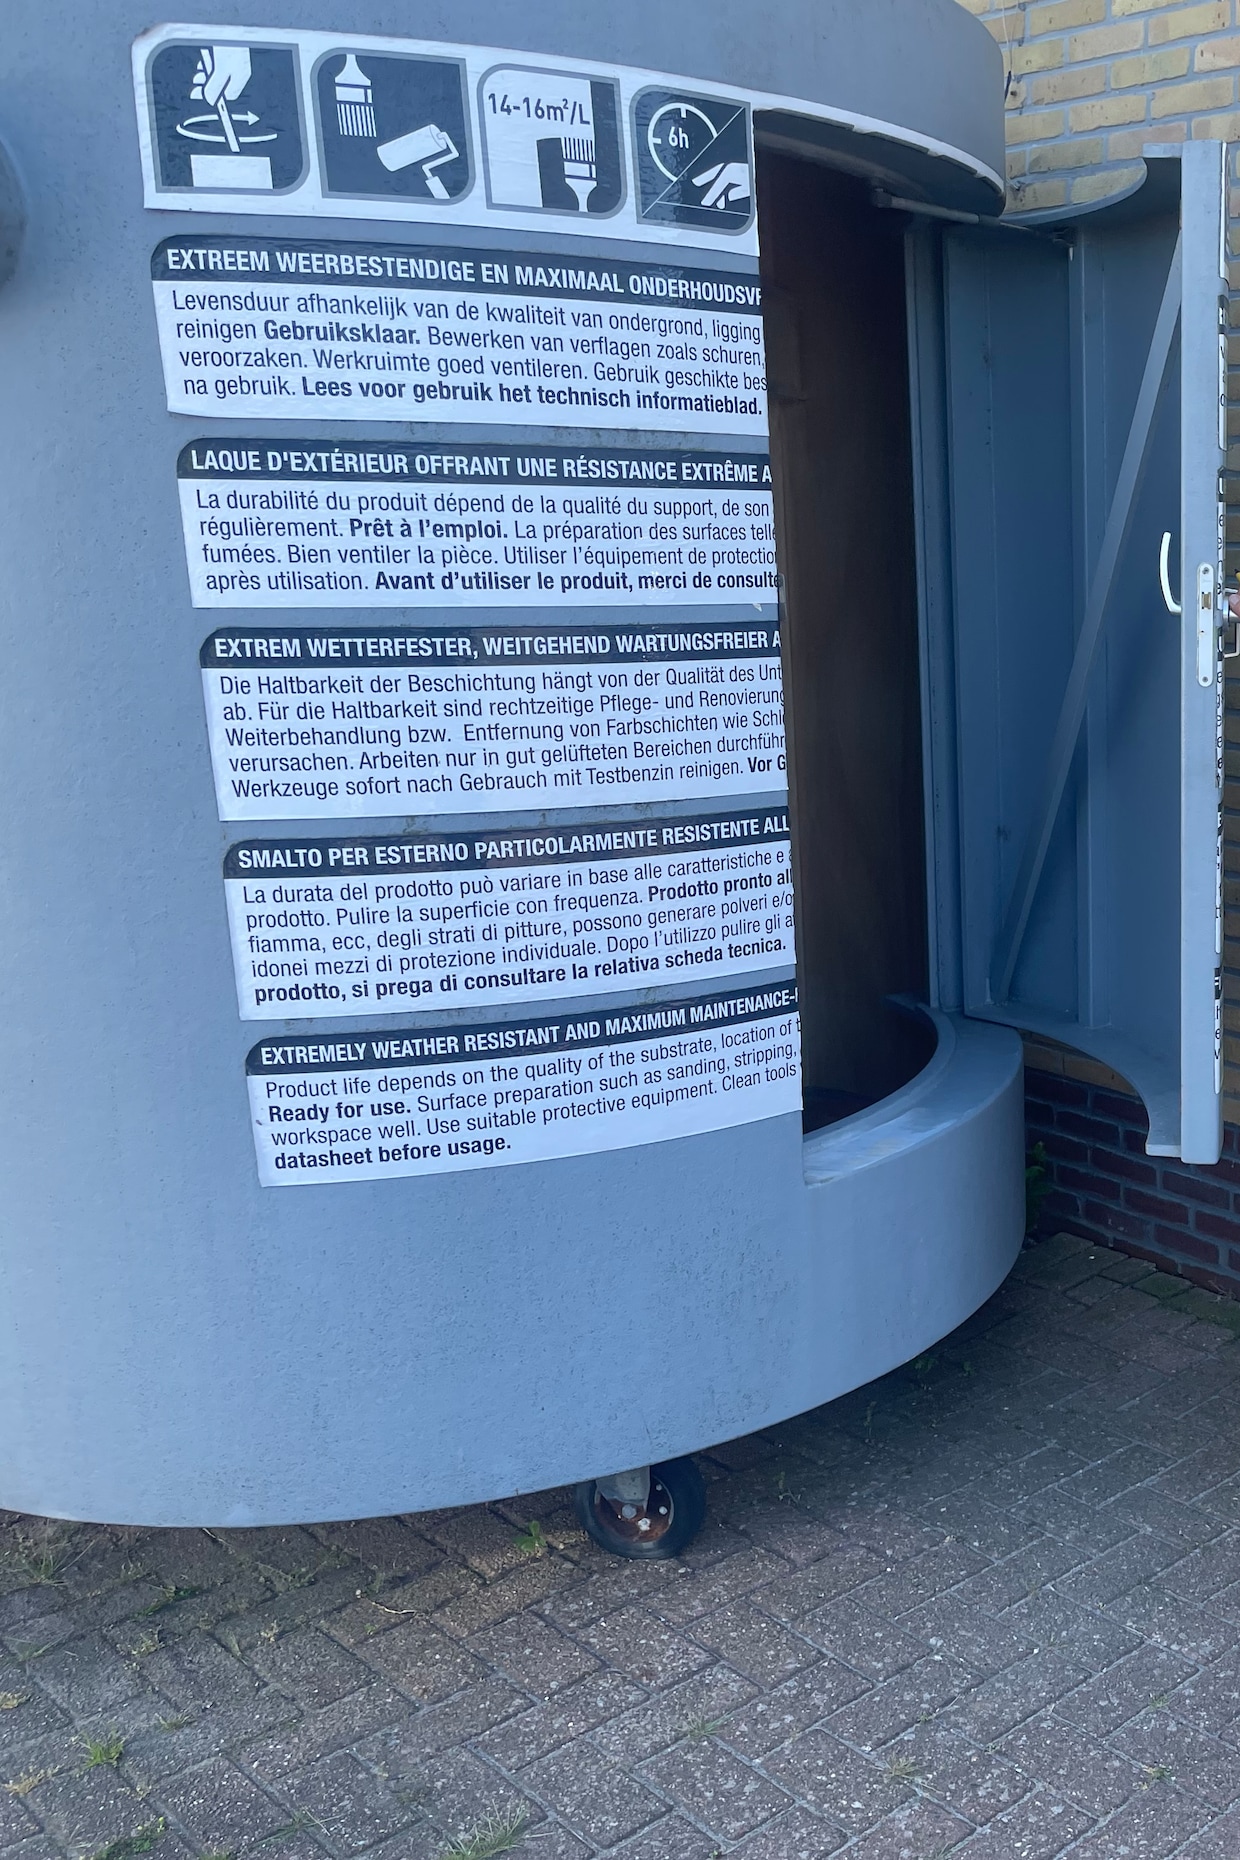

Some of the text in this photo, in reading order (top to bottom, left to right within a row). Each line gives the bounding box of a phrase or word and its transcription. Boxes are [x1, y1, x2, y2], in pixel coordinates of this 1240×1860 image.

[668, 126, 689, 149] 6h
[167, 249, 624, 293] EXTREEM WEERBESTENDIGE EN MAXIMAAL
[172, 290, 760, 345] Levensduur afhankelijk van de kwaliteit van ondergrond, ligging
[176, 318, 697, 361] reinigen Gebruiksklaar. Bewerken van verflagen zoals
[183, 375, 762, 415] na gebruik. Lees voor gebruik het technisch informatieblad.
[191, 448, 758, 482] LAQUE D'EXTÉRIEUR OFFRANT UNE RÉSISTANCE EXTRÊME
[196, 489, 769, 519] La durabilité du produit dépend de la qualité du support, de son
[200, 516, 343, 541] régulièrement.
[349, 517, 394, 537] Prêt
[400, 518, 412, 538] à
[514, 520, 537, 539] La
[543, 520, 643, 543] préparation
[649, 522, 677, 540] des
[682, 522, 747, 541] surfaces
[206, 570, 261, 594] après
[267, 571, 369, 590] utilisation.
[375, 571, 435, 590] Avant
[537, 571, 554, 590] le
[560, 571, 633, 594] produit,
[638, 571, 687, 589] merci
[692, 571, 712, 589] de
[214, 631, 768, 659] EXTREM WETTERFESTER, WEITGEHEND WARTUNGSFREIER
[220, 665, 755, 695] Die Haltbarkeit der Beschichtung hängt von der Qualität des
[228, 738, 712, 772] verursachen. Arbeiten nur in gut gelüfteten Bereichen
[231, 756, 772, 800] Werkzeuge sofort nach Gebrauch mit Testbenzin reinigen. Vor
[238, 818, 760, 868] SMALTO PER ESTERNO PARTICOLARMENTE RESISTENTE
[246, 872, 772, 932] prodotto. Pulire la superficie con frequenza. Prodotto pronto
[251, 958, 308, 978] idonei
[315, 956, 369, 975] mezzi
[376, 954, 392, 972] di
[399, 950, 496, 975] protezione
[502, 939, 601, 963] individuale.
[607, 936, 649, 954] Dopo
[721, 919, 761, 941] pulire
[765, 913, 781, 934] gli
[255, 938, 786, 1006] prodotto, si prega di consultare la relativa scheda tecnica.
[261, 1008, 686, 1065] EXTREMELY WEATHER RESISTANT AND MAXIMUM
[266, 1079, 338, 1099] Product
[343, 1077, 371, 1095] life
[378, 1070, 456, 1094] depends
[462, 1070, 484, 1085] on
[489, 1065, 518, 1082] the
[525, 1057, 582, 1081] quality
[588, 1052, 604, 1070] of
[608, 1050, 635, 1067] the
[641, 1038, 717, 1063] substrate,
[721, 1026, 775, 1049] location
[779, 1019, 792, 1036] of
[271, 1062, 796, 1147] workspace well. Use suitable protective equipment. Clean tools
[275, 1137, 511, 1169] datasheet before usage.
